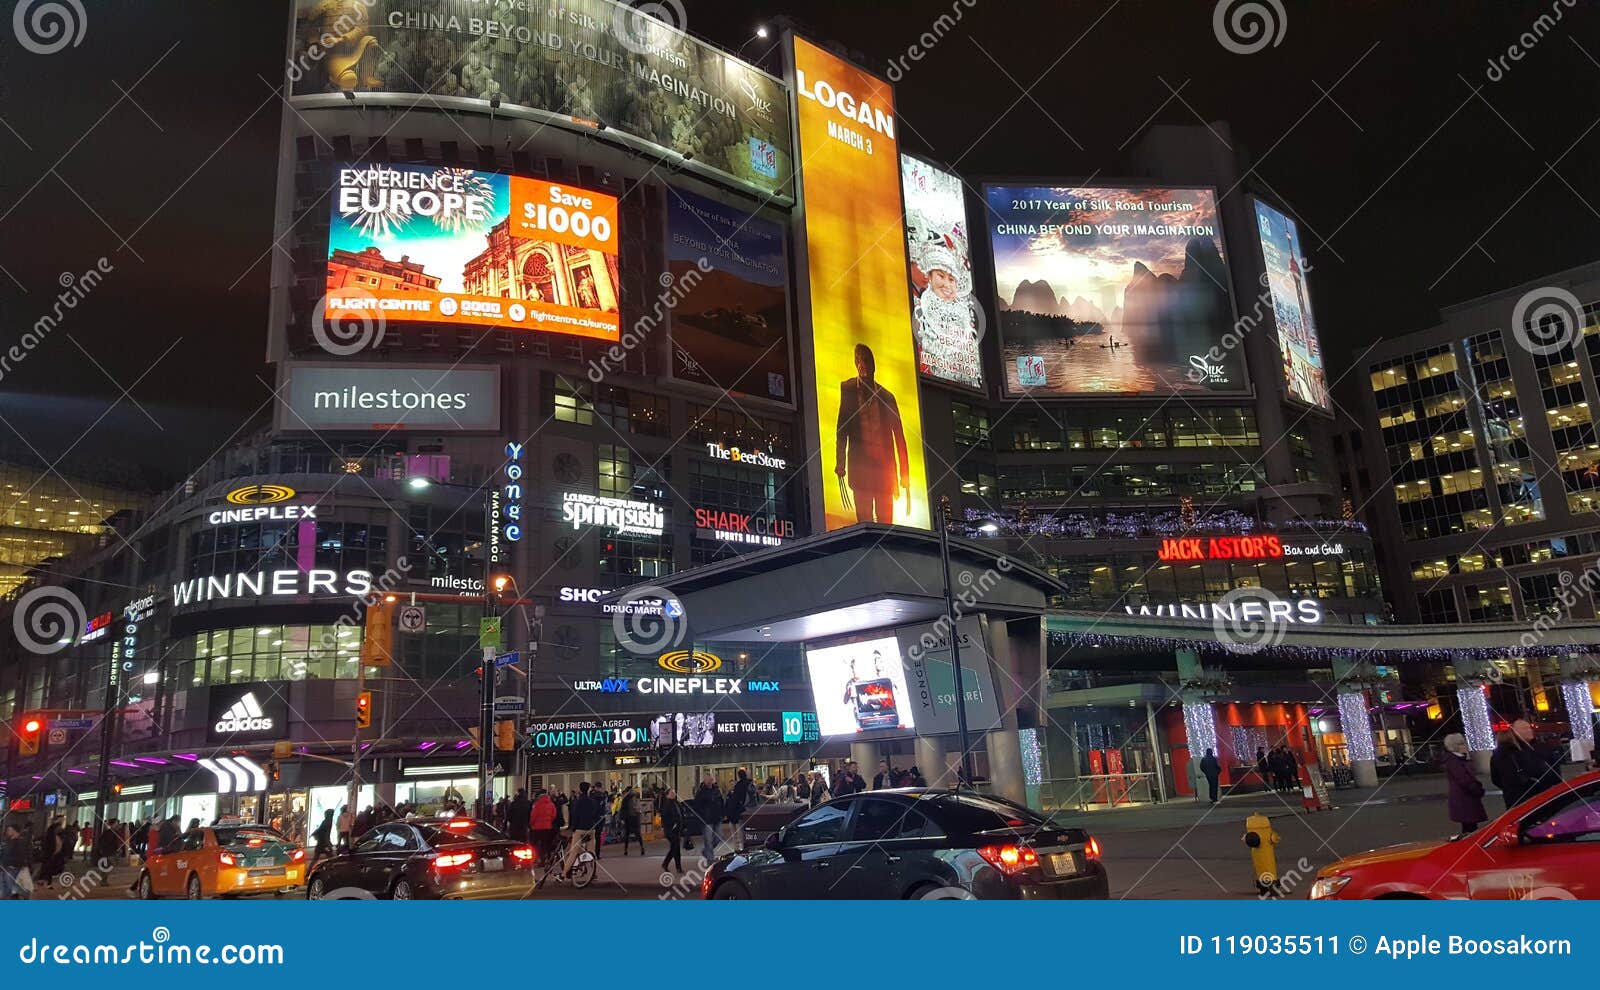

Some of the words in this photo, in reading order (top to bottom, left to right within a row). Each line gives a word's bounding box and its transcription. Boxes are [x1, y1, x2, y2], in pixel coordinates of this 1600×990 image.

[547, 8, 565, 20] of
[569, 12, 595, 29] Silk
[388, 11, 461, 33] CHINA
[469, 17, 563, 50] BEYOND
[570, 38, 625, 71] YOUR
[631, 61, 737, 120] IMAGINATION
[796, 69, 895, 140] LOGAN
[827, 119, 864, 152] MARCH
[865, 138, 873, 155] 3
[340, 168, 466, 195] EXPERIENCE
[339, 187, 487, 222] EUROPE
[549, 185, 593, 210] Save
[1012, 199, 1041, 211] 2017
[1045, 199, 1071, 211] Year
[1074, 199, 1088, 211] of
[1091, 199, 1112, 211] Silk
[1115, 200, 1144, 211] Road
[1148, 200, 1193, 212] Tourism
[523, 202, 611, 242] $1000
[997, 224, 1036, 235] CHINA
[1040, 224, 1092, 236] BEYOND
[1094, 224, 1131, 236] YOUR
[1134, 224, 1214, 236] IMAGINATION
[673, 233, 706, 251] BEYOND
[708, 246, 730, 259] YOUR
[329, 297, 379, 309] FLIGHT
[379, 298, 432, 312] CENTRE
[530, 310, 617, 332] flightcentre.ca/europe
[314, 385, 467, 410] milestones
[707, 442, 731, 460] The
[731, 447, 759, 464] Beer
[758, 452, 787, 470] Store
[505, 441, 523, 541] Yonge
[209, 505, 317, 525] CINEPLEX
[490, 491, 500, 562] DOWNTOWN
[695, 508, 750, 533] SHARK
[756, 517, 794, 538] CLUB
[1159, 537, 1204, 560] JACK
[1208, 535, 1282, 559] ASTOR'S
[1282, 544, 1302, 556] Bar
[1304, 544, 1320, 556] and
[1321, 543, 1344, 556] Grill
[173, 569, 373, 607] WINNERS
[431, 574, 485, 591] milesto
[603, 604, 633, 614] DRUG
[634, 606, 663, 615] MART
[110, 641, 119, 686] DOWNTOWN
[637, 677, 742, 694] CINEPLEX
[748, 681, 780, 692] IMAX
[914, 660, 929, 708] YONGE
[937, 690, 978, 705] SQRE
[215, 716, 273, 733] adidas
[531, 722, 547, 731] OOD
[548, 722, 565, 730] AND
[602, 720, 608, 728] A
[608, 719, 631, 728] GREAT
[717, 722, 739, 733] MEET
[740, 722, 756, 732] YOU
[757, 722, 778, 732] HERE.
[784, 717, 801, 735] 10
[531, 727, 651, 748] OMBINAT10N.
